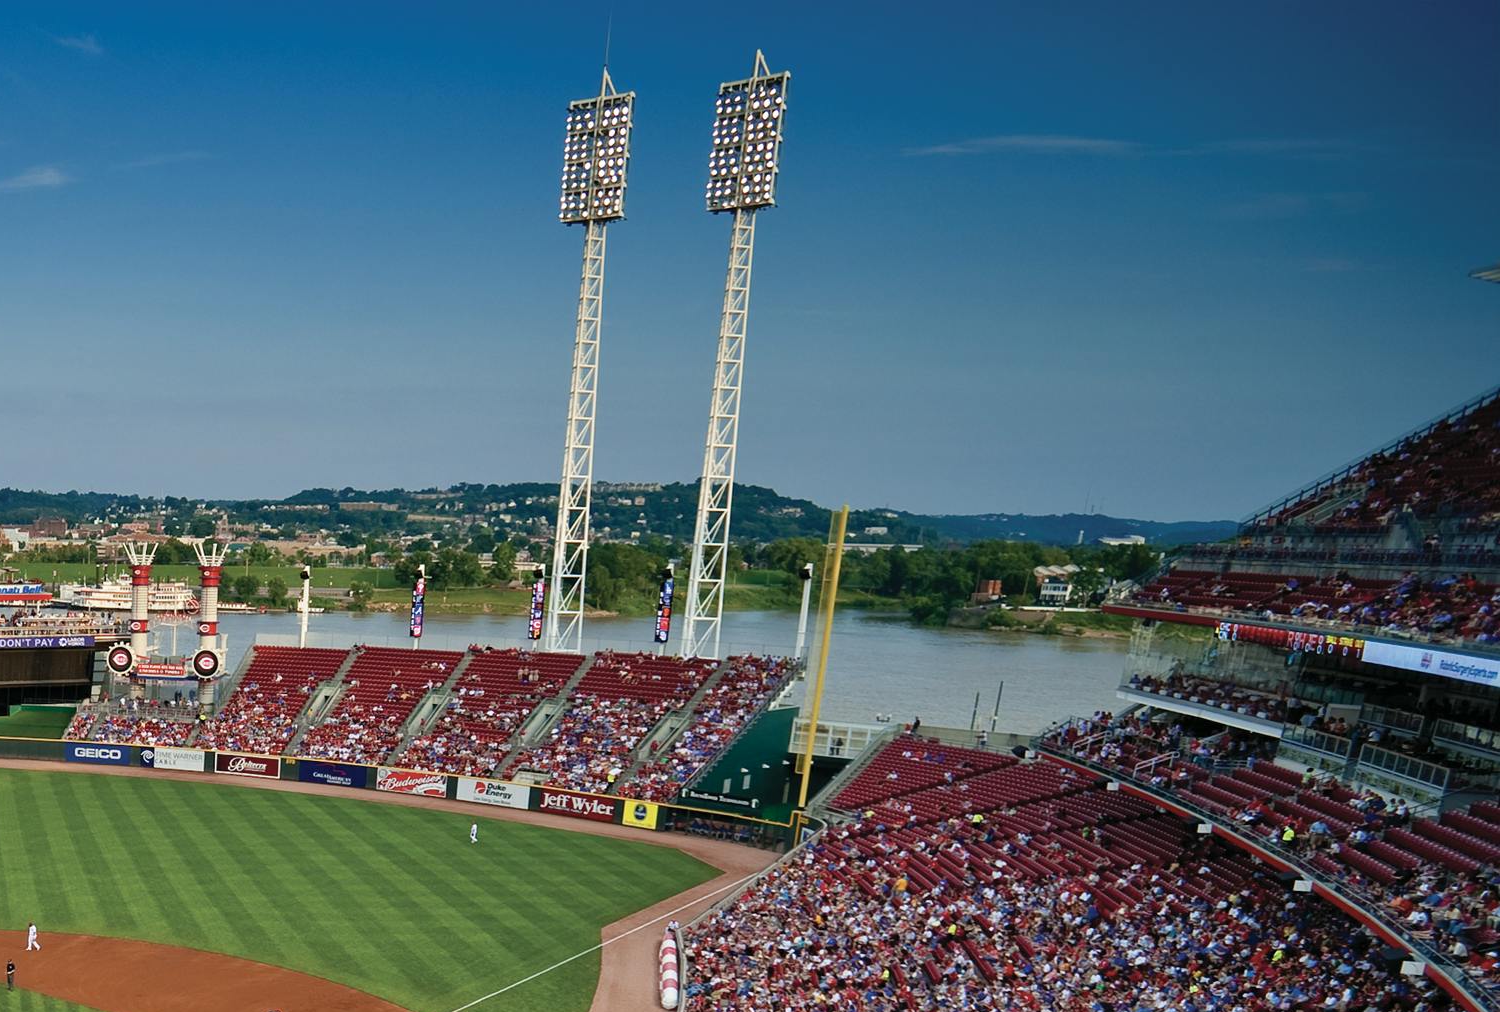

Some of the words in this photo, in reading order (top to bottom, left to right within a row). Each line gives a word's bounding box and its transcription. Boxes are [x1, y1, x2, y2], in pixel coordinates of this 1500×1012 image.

[23, 585, 44, 594] Bell
[0, 639, 32, 648] DON'T
[35, 638, 54, 647] PAY
[74, 747, 122, 760] GEICO
[156, 750, 174, 760] TIME
[173, 752, 203, 761] WARNER
[155, 758, 177, 766] CABLE
[384, 774, 441, 790] Budweiser
[487, 783, 506, 792] Duke
[486, 788, 512, 800] Energy
[540, 792, 571, 808] Jeff
[571, 796, 614, 816] Wyler
